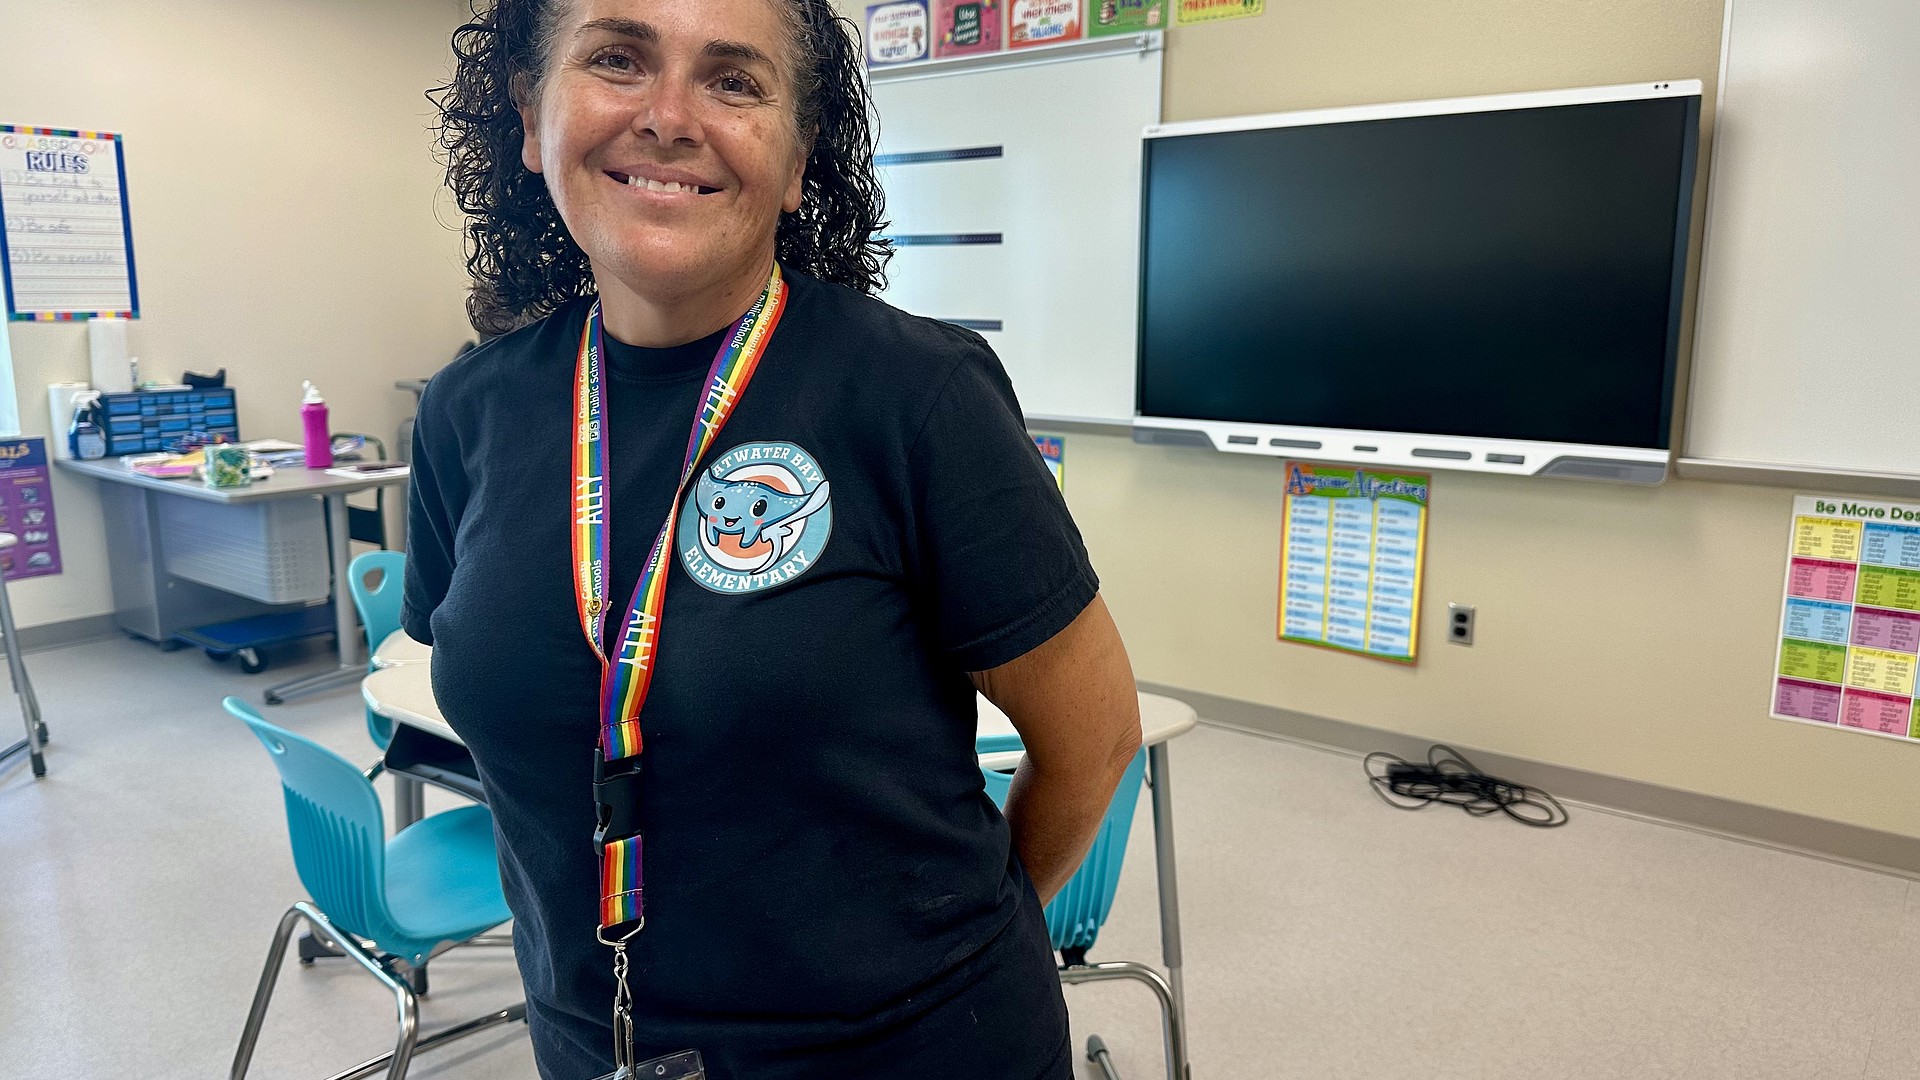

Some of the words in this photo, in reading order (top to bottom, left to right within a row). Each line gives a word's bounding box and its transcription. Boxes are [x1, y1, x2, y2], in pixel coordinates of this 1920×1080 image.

[26, 150, 90, 174] RULES
[730, 317, 755, 349] Schools
[589, 345, 599, 384] Schools
[589, 384, 600, 416] Public
[700, 375, 737, 438] ALLY
[789, 453, 822, 483] BAY
[1287, 465, 1350, 495] Awesome
[1348, 471, 1427, 501] Adjectives
[576, 475, 603, 525] ALLY
[1816, 500, 1836, 514] Be
[1841, 503, 1885, 518] More
[684, 545, 811, 590] ELEMENTARY
[618, 608, 656, 671] ALLY
